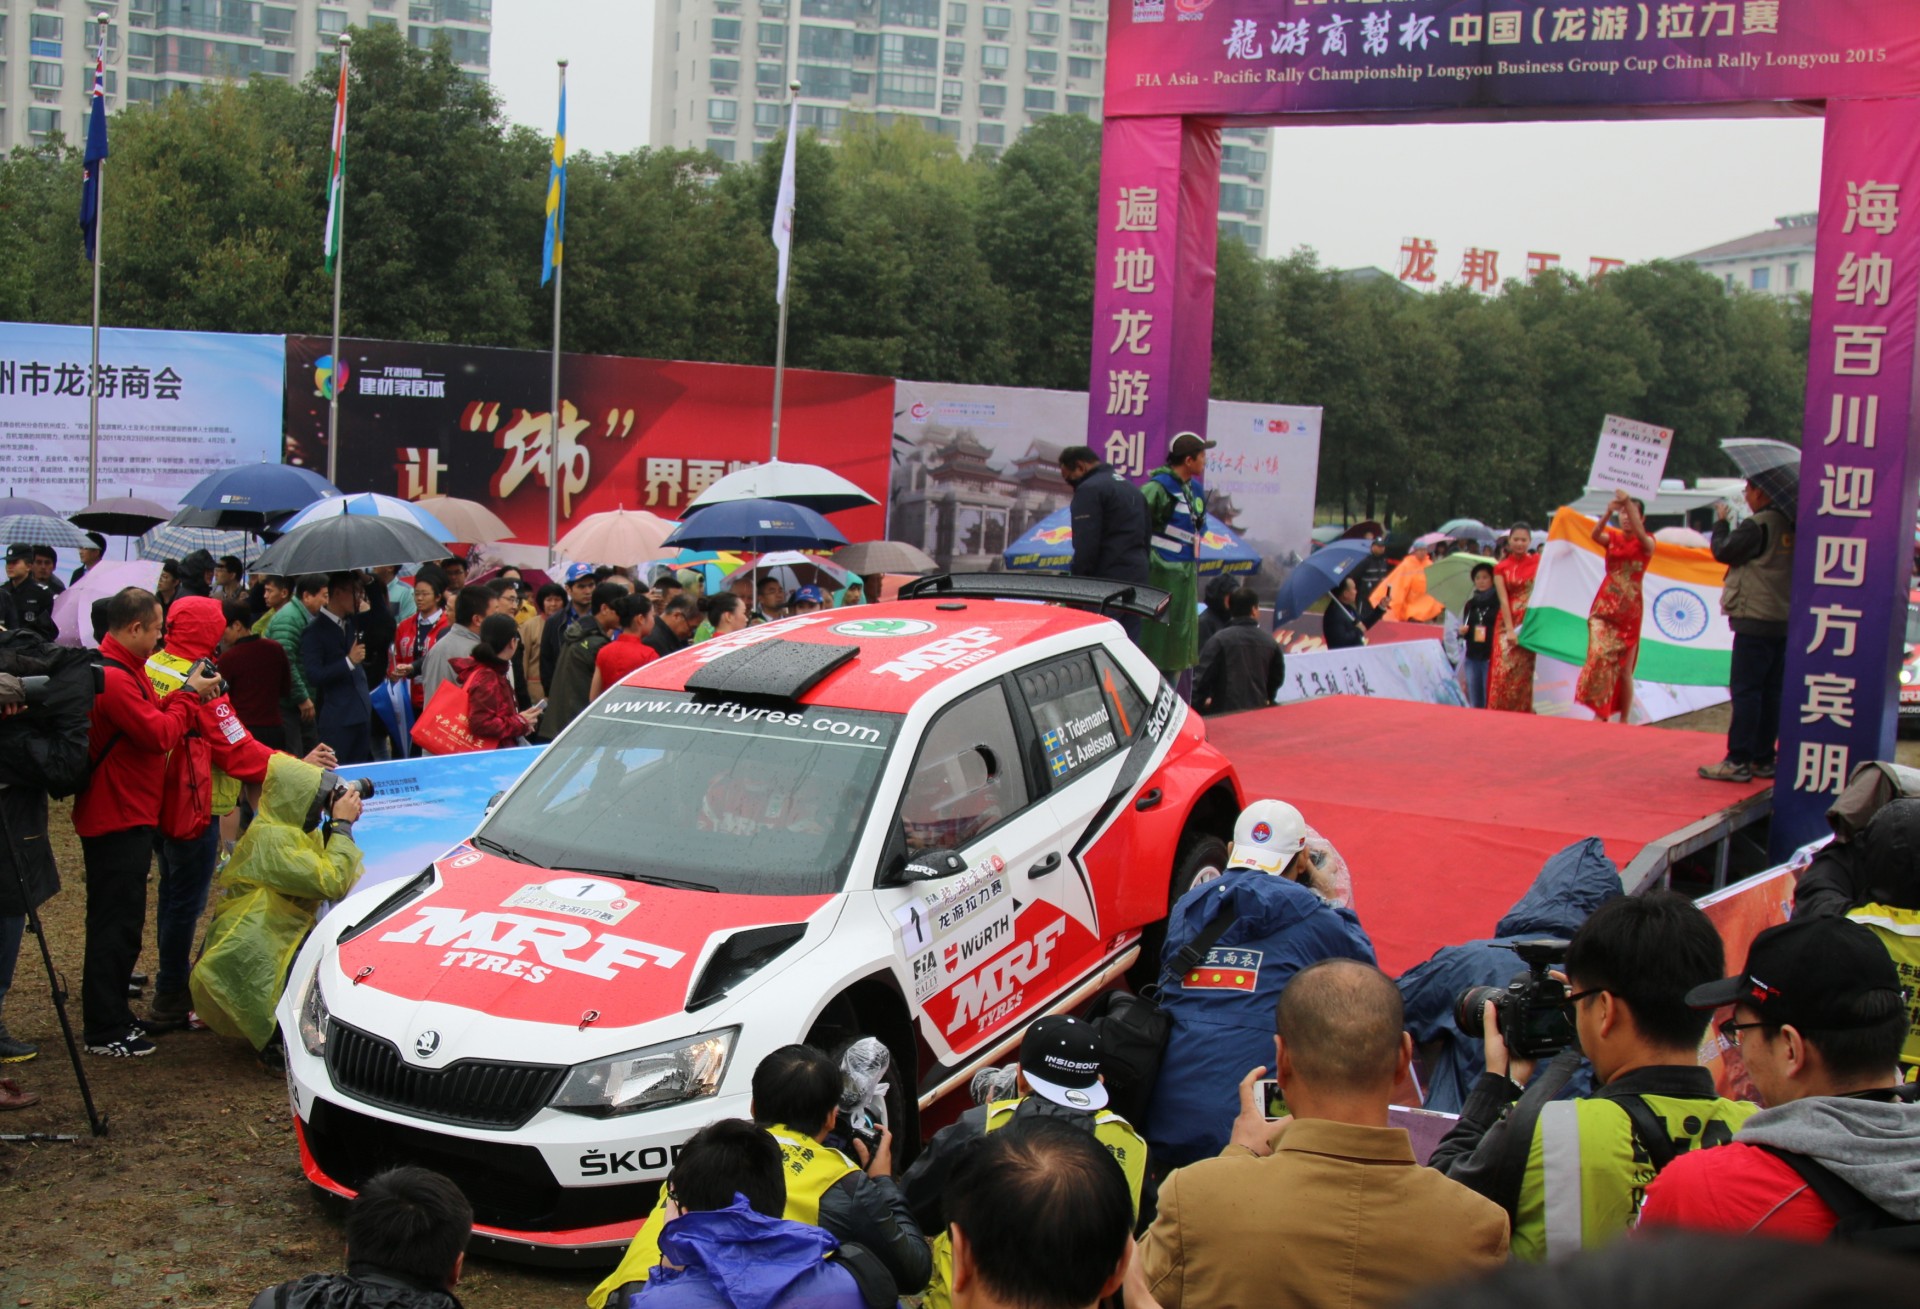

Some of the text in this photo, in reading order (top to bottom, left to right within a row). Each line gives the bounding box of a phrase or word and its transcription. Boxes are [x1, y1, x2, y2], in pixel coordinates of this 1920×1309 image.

[1135, 73, 1162, 88] FIA
[1168, 71, 1199, 87] Asia
[1213, 68, 1262, 84] Pacific
[1266, 66, 1303, 85] Rally
[1308, 63, 1423, 83] Championship
[1427, 62, 1493, 82] Longyou
[1497, 60, 1564, 75] Business
[1568, 58, 1619, 75] Group
[1624, 57, 1658, 74] Cup
[1662, 54, 1712, 70] China
[1718, 52, 1761, 71] Rally
[1765, 49, 1841, 69] Longyou
[1845, 48, 1888, 64] 2015
[360, 377, 445, 398] 建材家居城
[644, 457, 759, 507] 界更
[1793, 180, 1901, 796] 海纳百川迎四方宾朋
[869, 626, 1005, 682] MRF
[941, 648, 997, 671] TYRES
[603, 699, 880, 744] www.mrftyres.com
[1057, 704, 1109, 746] P. Tidemand
[1147, 683, 1175, 743] ŠKODA
[1065, 730, 1116, 769] E. Axelsson
[576, 883, 595, 898] 1
[905, 863, 938, 877] MRF
[910, 906, 923, 943] 1
[939, 878, 1003, 930] 龙游拉力赛
[379, 906, 687, 981] MRF
[439, 951, 553, 984] TYRES
[915, 975, 938, 998] RALLY
[947, 915, 1066, 1036] MRF
[978, 989, 1024, 1033] TYRES
[1045, 1055, 1100, 1070] INSIDEOUT
